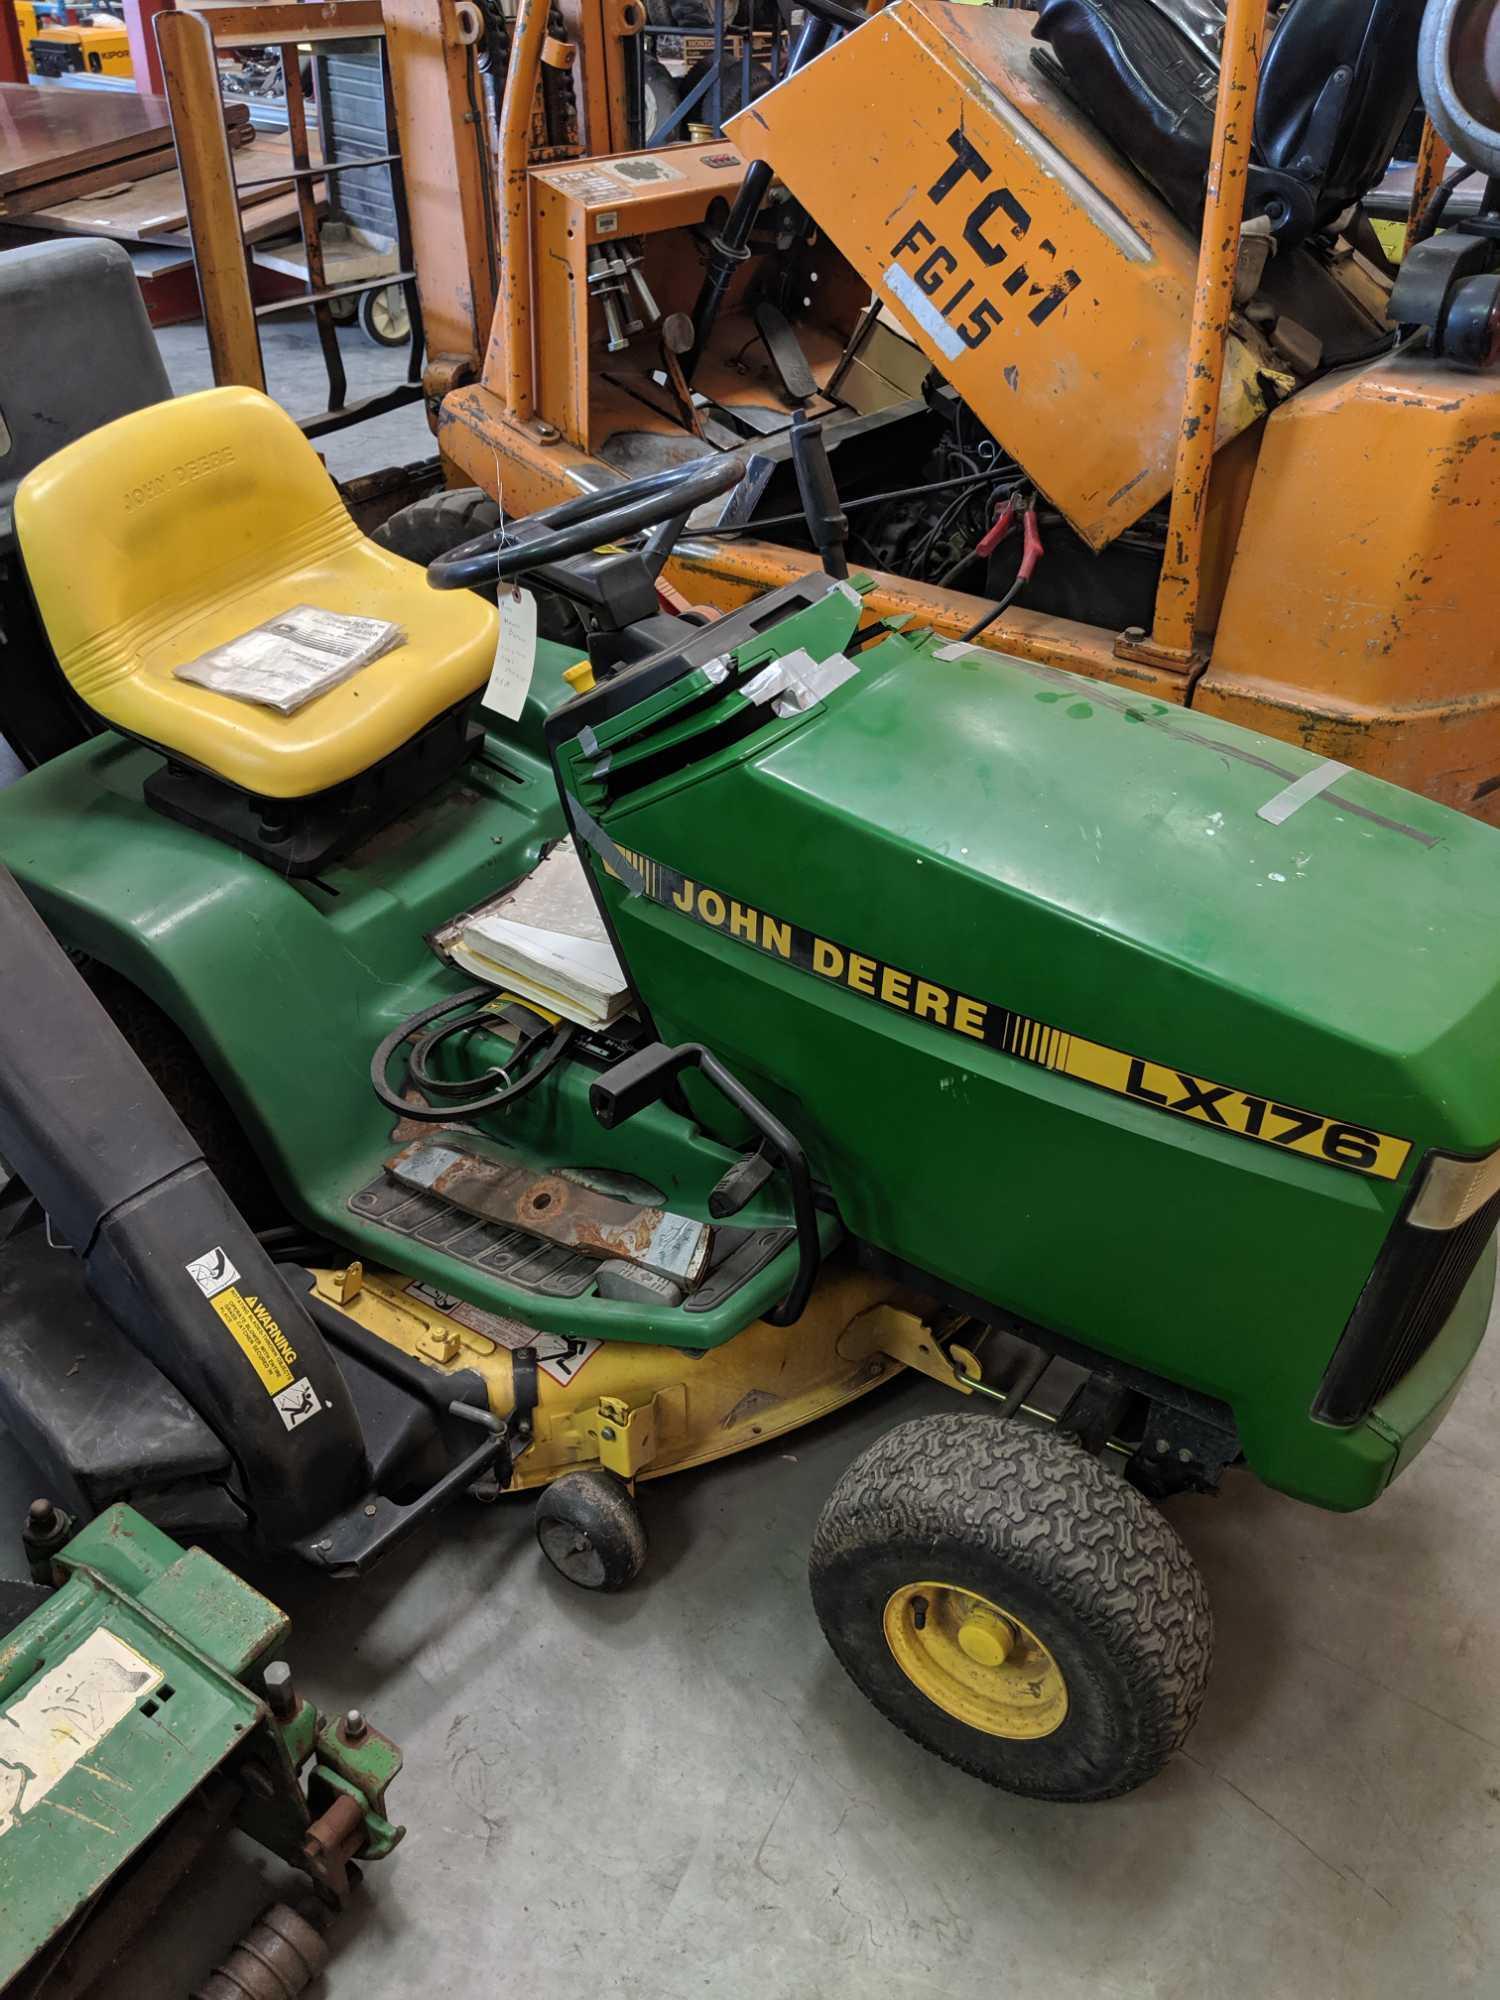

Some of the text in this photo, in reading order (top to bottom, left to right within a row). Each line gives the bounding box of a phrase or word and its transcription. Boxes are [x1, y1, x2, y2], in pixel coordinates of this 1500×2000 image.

[890, 220, 1004, 350] FG15
[123, 446, 237, 514] JOHN DEERE
[672, 879, 988, 1040] JOHN DEERE
[1125, 1058, 1380, 1169] LX176
[252, 1303, 298, 1364] WARNING
